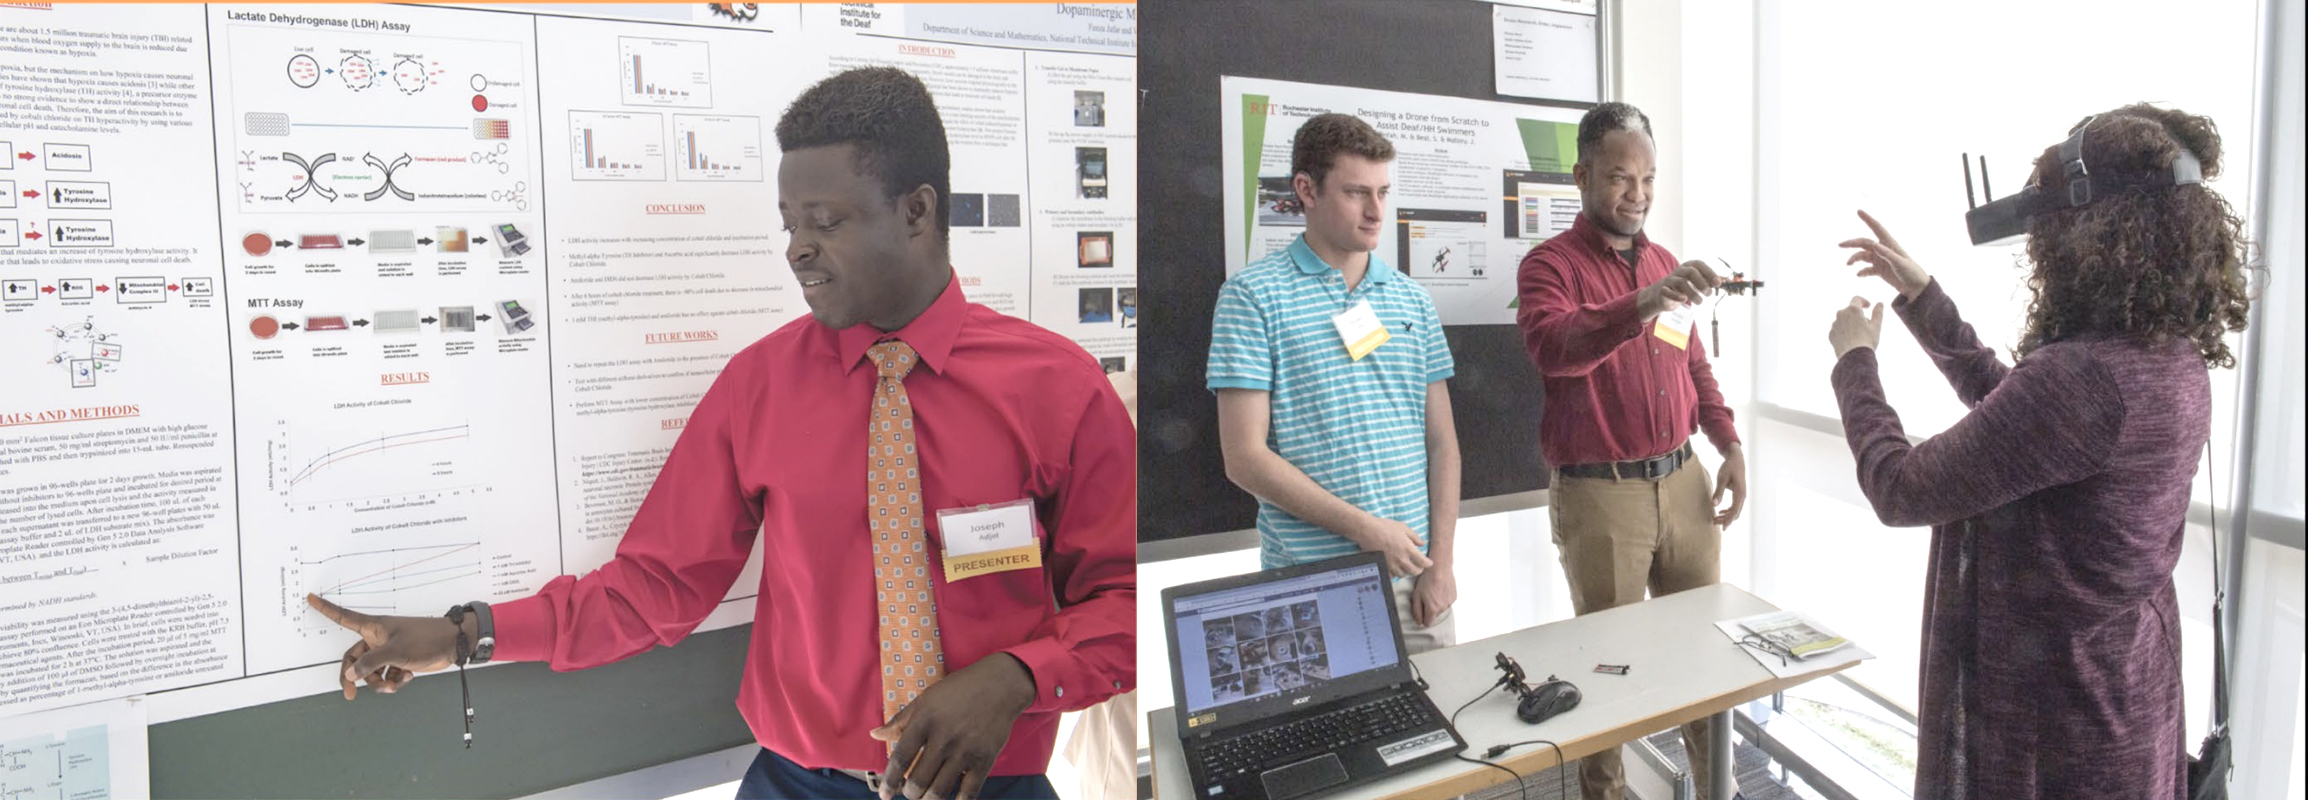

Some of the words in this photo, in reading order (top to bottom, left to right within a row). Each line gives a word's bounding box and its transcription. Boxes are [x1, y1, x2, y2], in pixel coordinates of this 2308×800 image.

[840, 8, 869, 18] Institute
[871, 10, 881, 19] for
[1056, 4, 1123, 21] Dopaminergic
[228, 10, 266, 22] Lactate
[269, 13, 348, 27] Dehydrogenase
[351, 18, 379, 30] (LDH)
[381, 21, 411, 33] Assay
[840, 18, 853, 27] the
[854, 19, 871, 28] Deaf
[923, 23, 960, 34] Department
[962, 26, 968, 35] of
[970, 27, 993, 38] Science
[994, 30, 1005, 39] and
[1050, 34, 1076, 43] National
[1078, 36, 1105, 45] Technical
[899, 44, 956, 57] INTRODUCTION
[1250, 101, 1278, 116] RIT
[1358, 108, 1396, 120] Designing
[1406, 113, 1429, 121] Drone
[1431, 115, 1449, 123] from
[1451, 116, 1479, 126] Scratch
[1376, 122, 1398, 130] Assist
[1401, 123, 1435, 132] Deaf/HH
[1437, 126, 1476, 136] Swimmers
[646, 204, 705, 214] CONCLUSION
[248, 299, 269, 308] MTT
[273, 298, 303, 308] Assay
[645, 332, 682, 343] FUTURE
[685, 330, 718, 341] WORKS
[381, 372, 430, 384] RESULTS
[37, 409, 66, 421] AND
[70, 405, 140, 419] METHODS
[970, 521, 1005, 533] Joseph
[953, 554, 1030, 573] PRESENTER
[1292, 696, 1311, 705] acer
